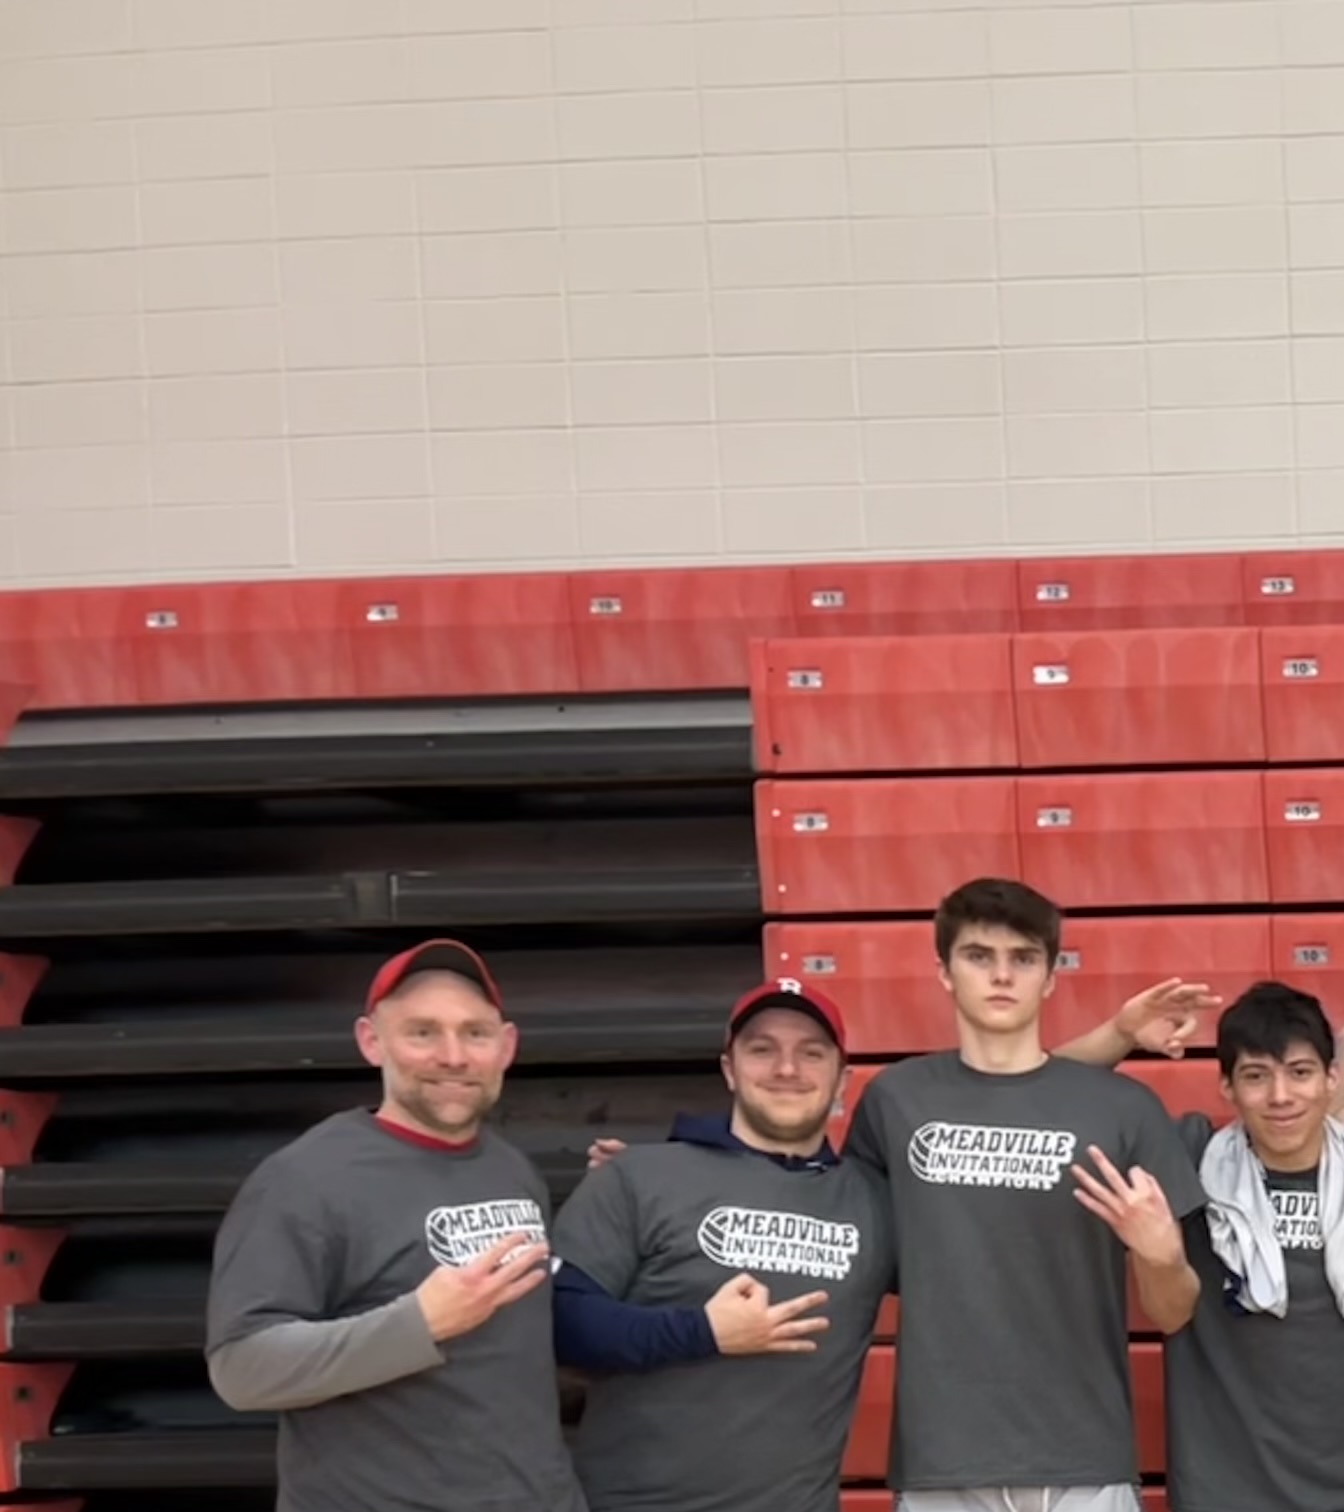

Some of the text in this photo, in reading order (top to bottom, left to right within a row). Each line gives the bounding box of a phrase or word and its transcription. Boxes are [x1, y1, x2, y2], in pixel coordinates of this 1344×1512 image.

[935, 1128, 1069, 1157] MEADVILLE
[929, 1151, 1056, 1176] INVITATIONAL
[730, 1212, 854, 1247] MEADVILLE
[726, 1237, 846, 1265] INVITATIONAL
